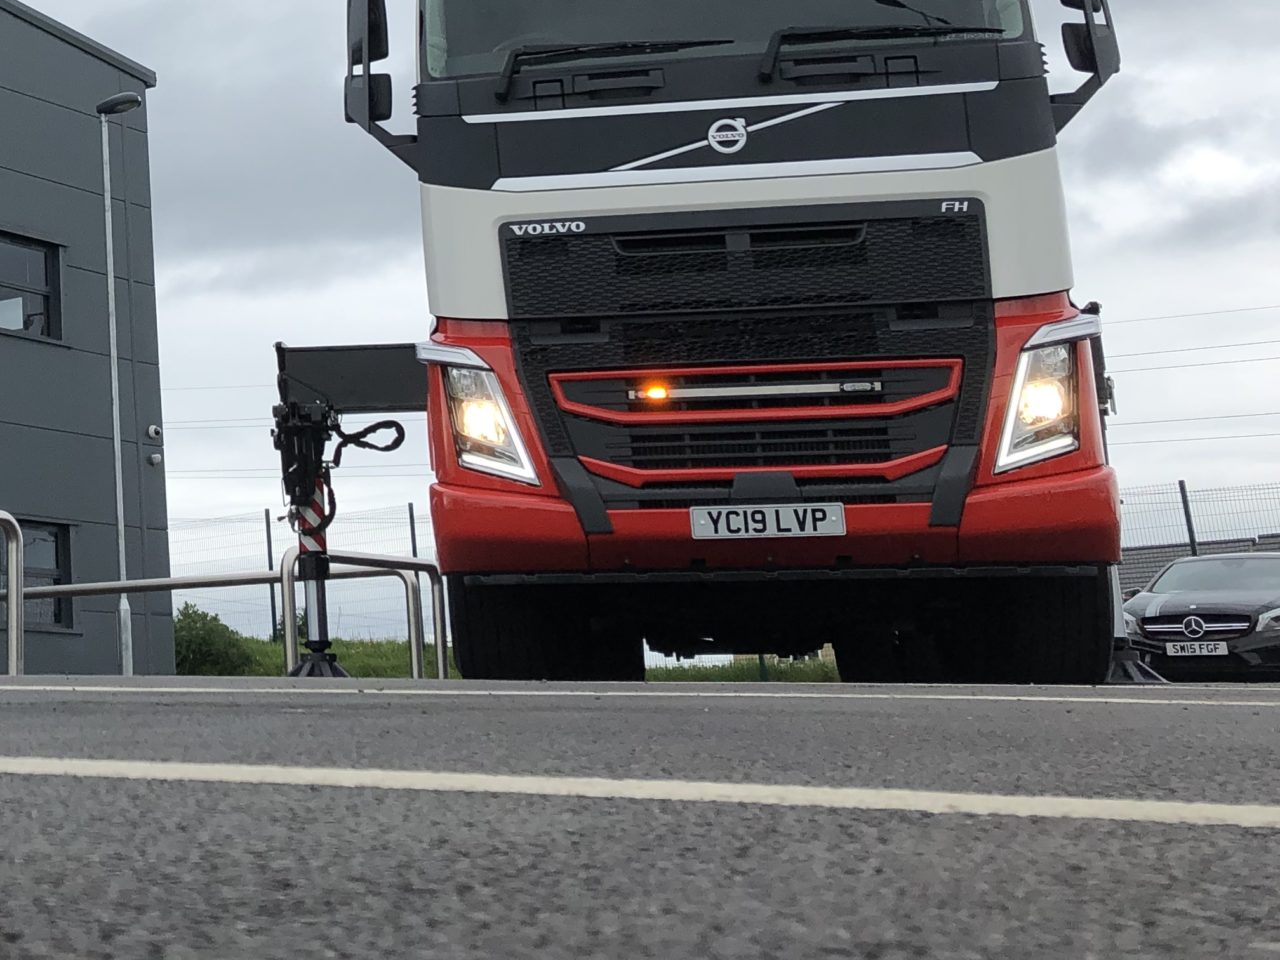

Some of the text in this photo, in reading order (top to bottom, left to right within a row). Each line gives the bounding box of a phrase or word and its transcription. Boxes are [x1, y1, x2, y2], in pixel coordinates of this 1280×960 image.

[711, 132, 745, 140] VOLVO
[941, 201, 969, 213] FH
[509, 221, 586, 236] VOLVO
[707, 508, 828, 535] YC19 LVP
[1199, 642, 1220, 654] FGF
